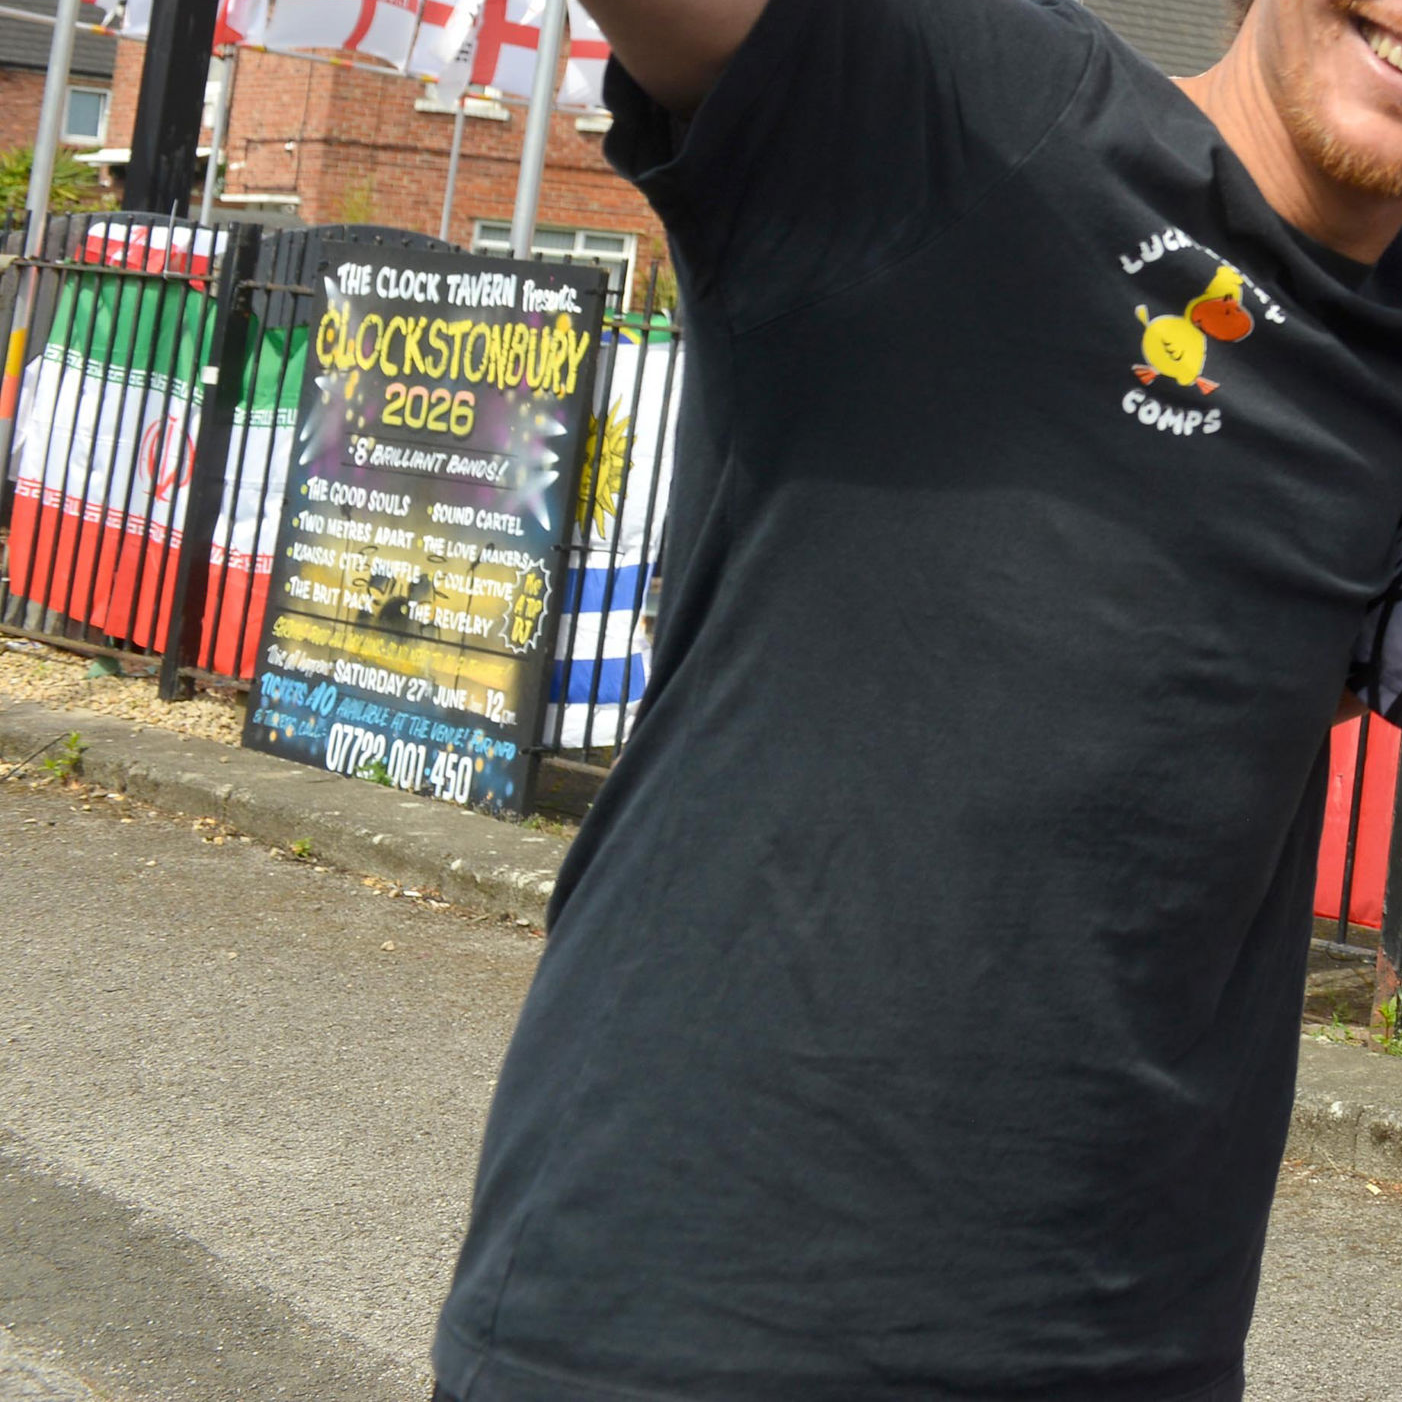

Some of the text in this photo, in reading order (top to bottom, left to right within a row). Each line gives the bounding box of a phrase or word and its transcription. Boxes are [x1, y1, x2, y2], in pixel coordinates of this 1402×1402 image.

[337, 262, 373, 295] THE
[376, 266, 440, 304] CLOCK
[447, 272, 517, 308] TAVERN
[316, 299, 590, 394] CLOCKSTONBURY
[381, 382, 475, 436] 2026
[1122, 388, 1222, 436] COMPS
[369, 443, 450, 473] BRILLIANT
[307, 476, 411, 517] THE GOOD SOULS
[298, 510, 415, 549] TWO METRES APART
[431, 501, 525, 537] SOUND CARTEL
[292, 542, 336, 568] KANSAS
[339, 552, 367, 571] CITY
[370, 555, 420, 584] SHUFFLE
[423, 535, 531, 569] THE LOVE MAKERS
[290, 575, 374, 615] THE BRIT PACK
[408, 600, 494, 638] THE REVELRY
[334, 659, 406, 697] SATURDAY
[433, 686, 467, 711] JUNE
[261, 671, 309, 706] TICKETS
[390, 712, 408, 731] AT
[408, 715, 431, 739] THE
[430, 721, 470, 748] VENUE!
